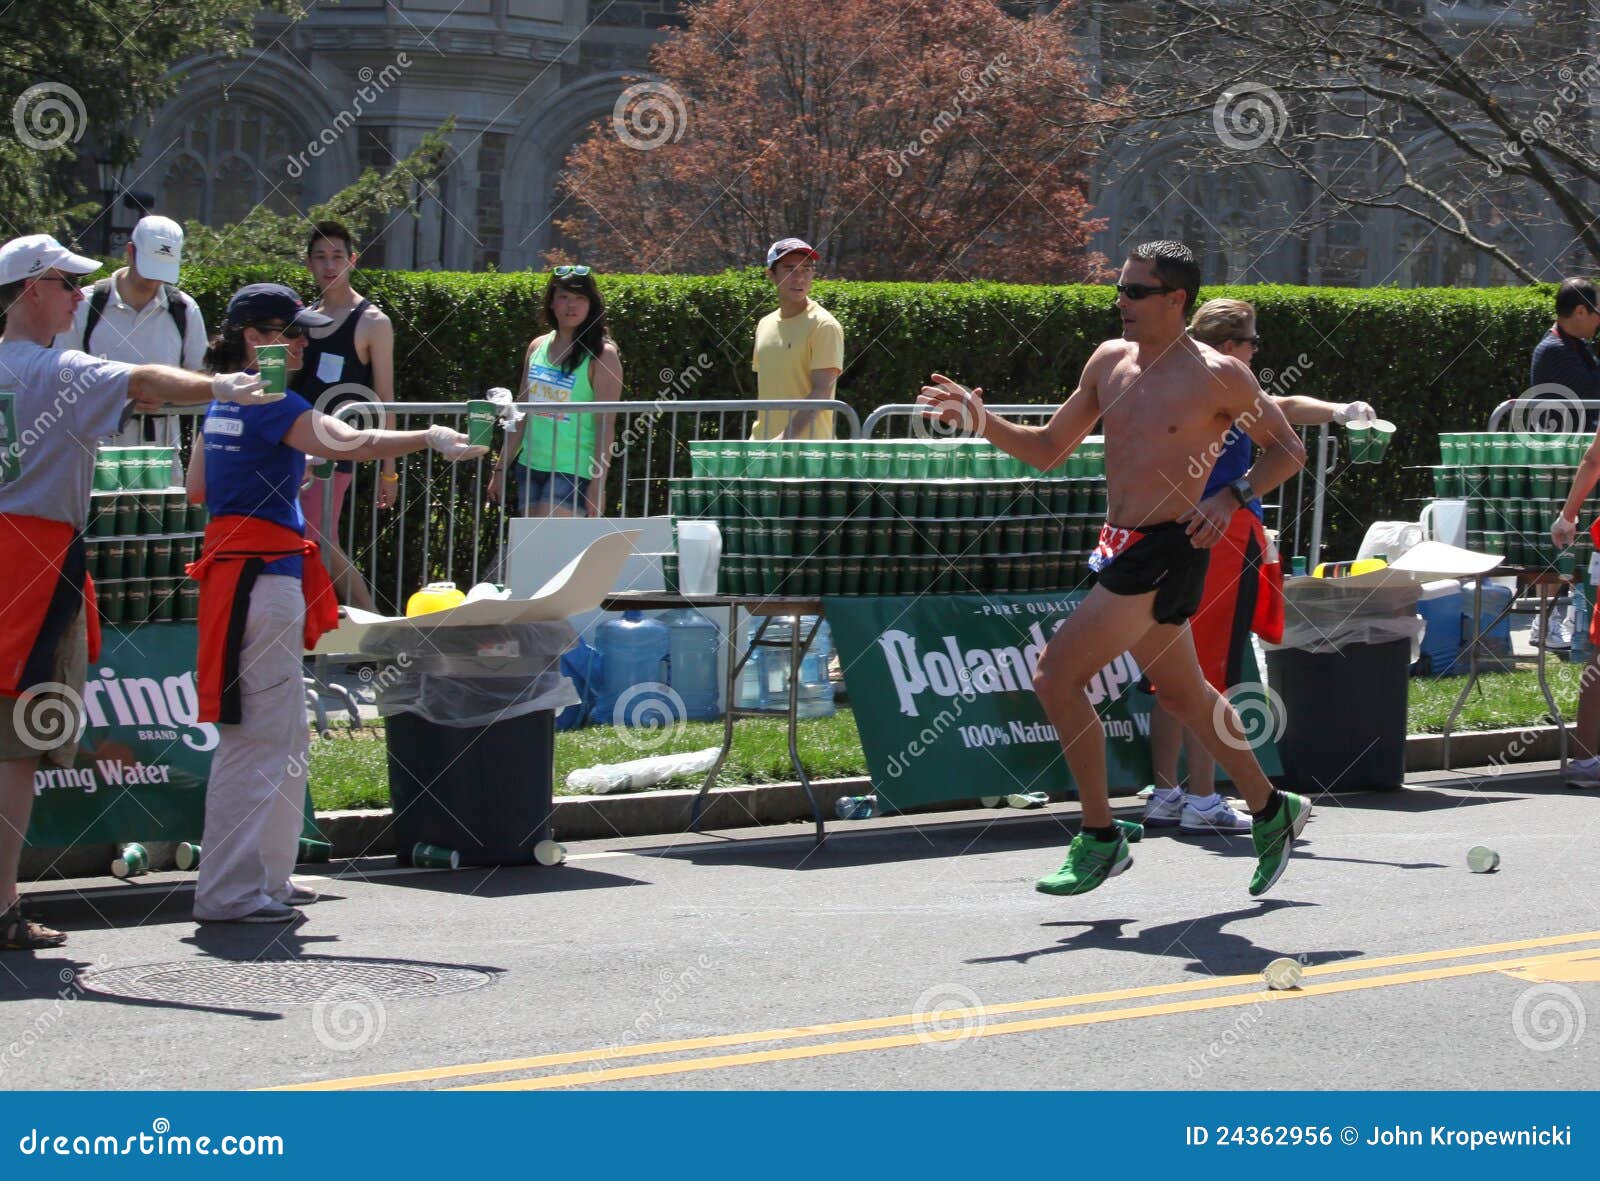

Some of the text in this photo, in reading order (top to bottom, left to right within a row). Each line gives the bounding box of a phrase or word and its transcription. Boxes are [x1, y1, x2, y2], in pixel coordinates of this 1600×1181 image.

[1026, 600, 1081, 614] QUALIT
[83, 666, 220, 752] ring
[138, 729, 178, 742] BRAND
[957, 723, 1011, 748] 100%
[33, 759, 172, 797] pring Water
